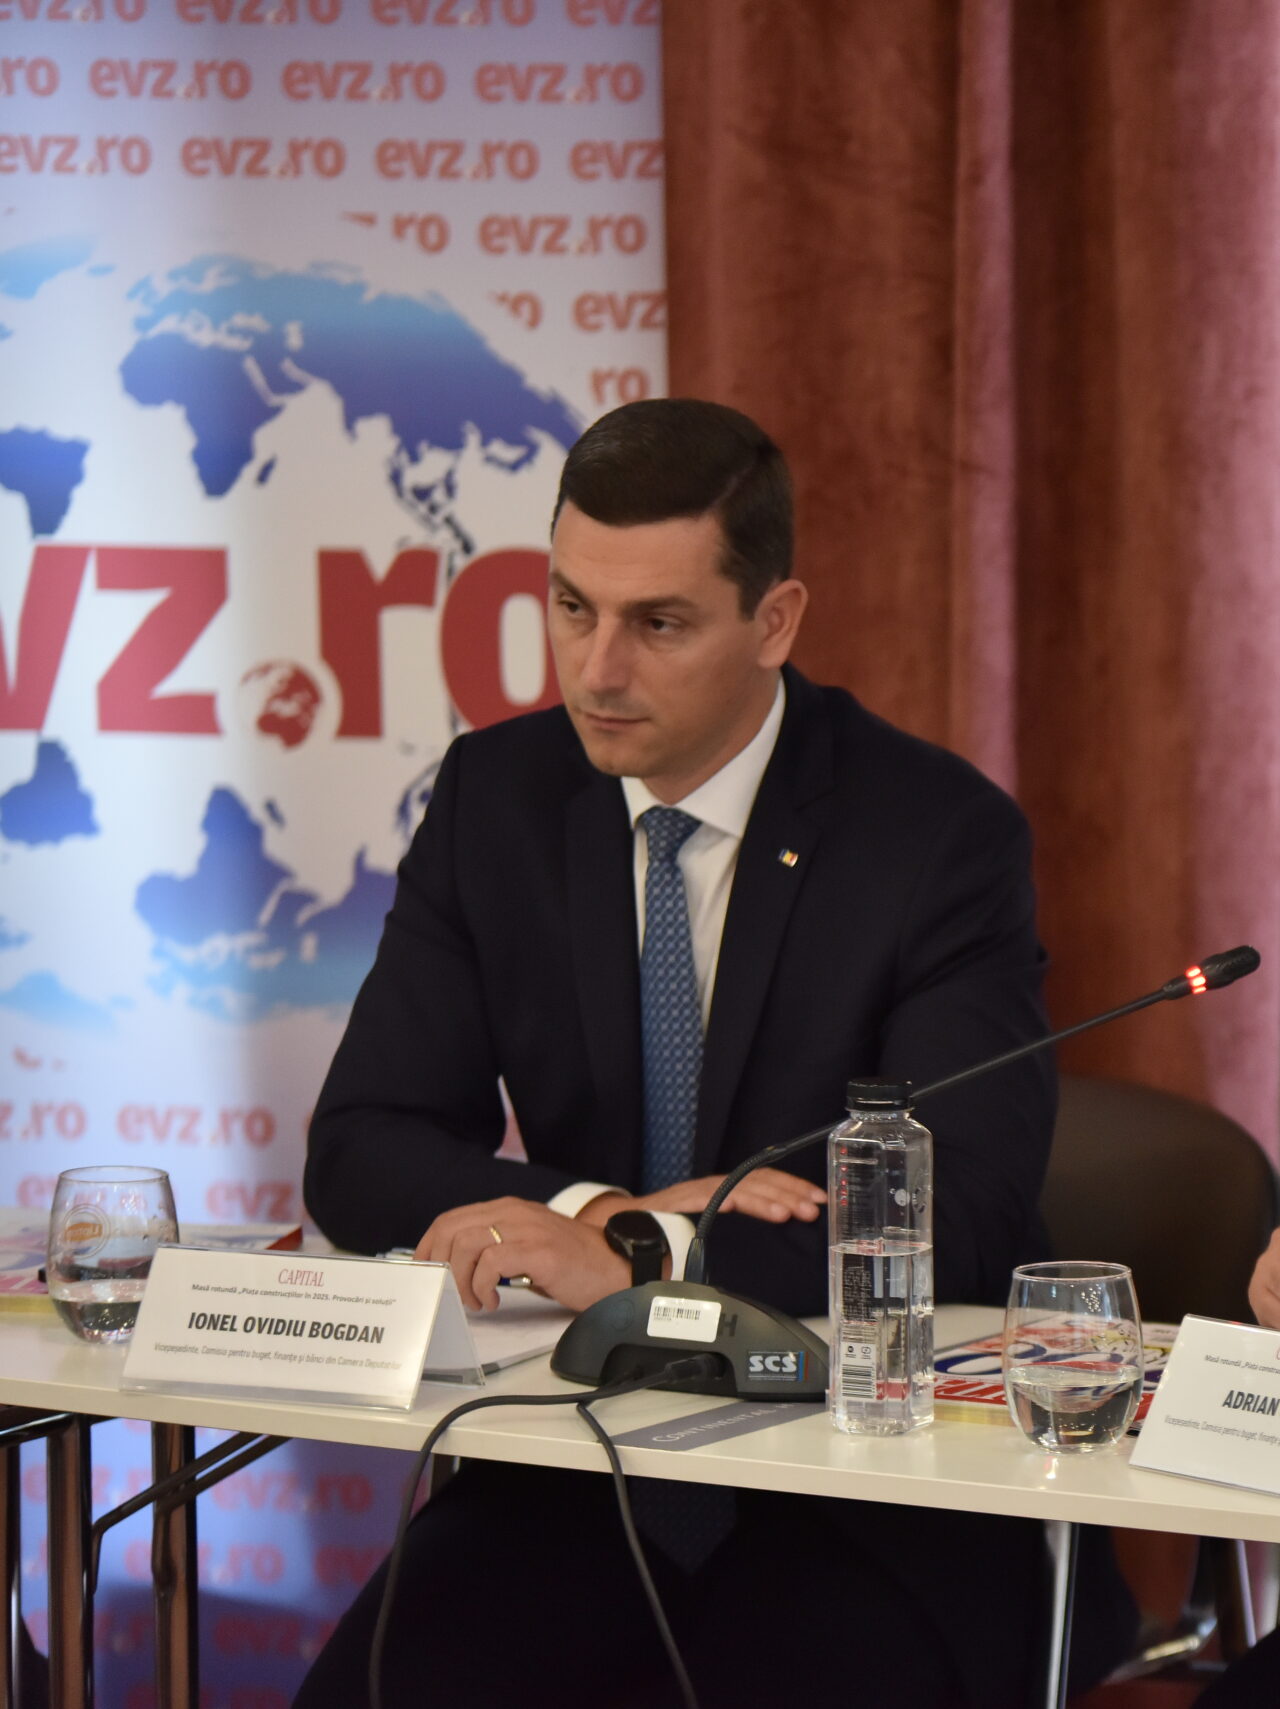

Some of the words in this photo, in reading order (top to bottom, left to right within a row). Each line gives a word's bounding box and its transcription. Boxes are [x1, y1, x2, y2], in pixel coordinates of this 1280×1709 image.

[89, 57, 253, 101] evz.ro
[281, 59, 446, 103] evz.ro
[474, 62, 644, 104] evz.ro
[181, 136, 347, 179] evz.ro
[374, 138, 541, 181] evz.ro
[478, 214, 648, 255] evz.ro
[192, 1283, 210, 1292] Masă
[211, 1286, 237, 1294] rotundă
[278, 1268, 325, 1287] CAPITAL
[188, 1312, 238, 1332] IONEL
[243, 1316, 306, 1338] OVIDIU
[308, 1321, 385, 1344] BOGDAN
[749, 1354, 797, 1373] SCS
[1222, 1390, 1280, 1417] ADRIAN
